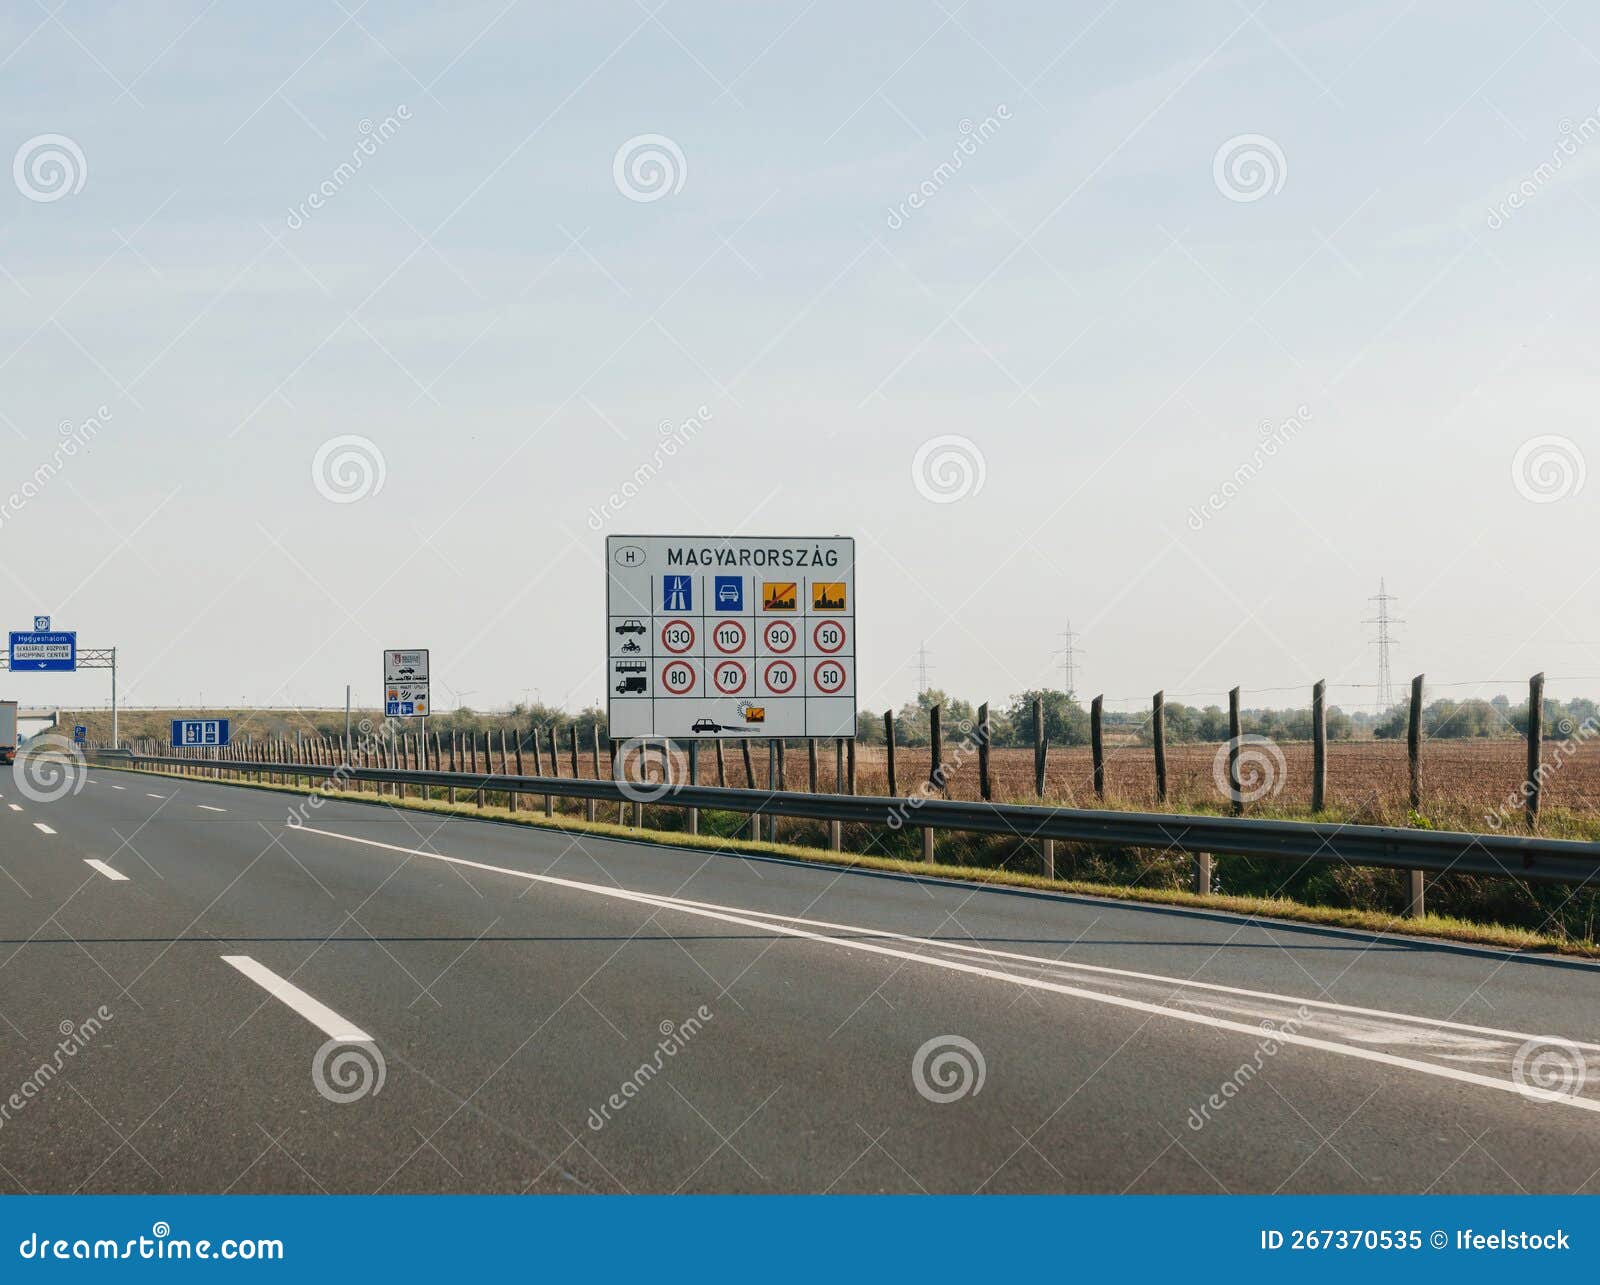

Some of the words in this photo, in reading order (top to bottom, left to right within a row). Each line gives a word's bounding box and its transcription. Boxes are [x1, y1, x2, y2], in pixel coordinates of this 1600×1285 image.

[626, 551, 635, 562] H
[667, 545, 838, 567] MAGYARORSZÁG
[667, 630, 690, 644] 130
[719, 631, 739, 644] 110
[771, 630, 789, 643] 90
[823, 630, 838, 643] 50
[671, 671, 686, 684] 80
[723, 671, 738, 684] 70
[773, 670, 788, 684] 70
[823, 670, 838, 683] 50
